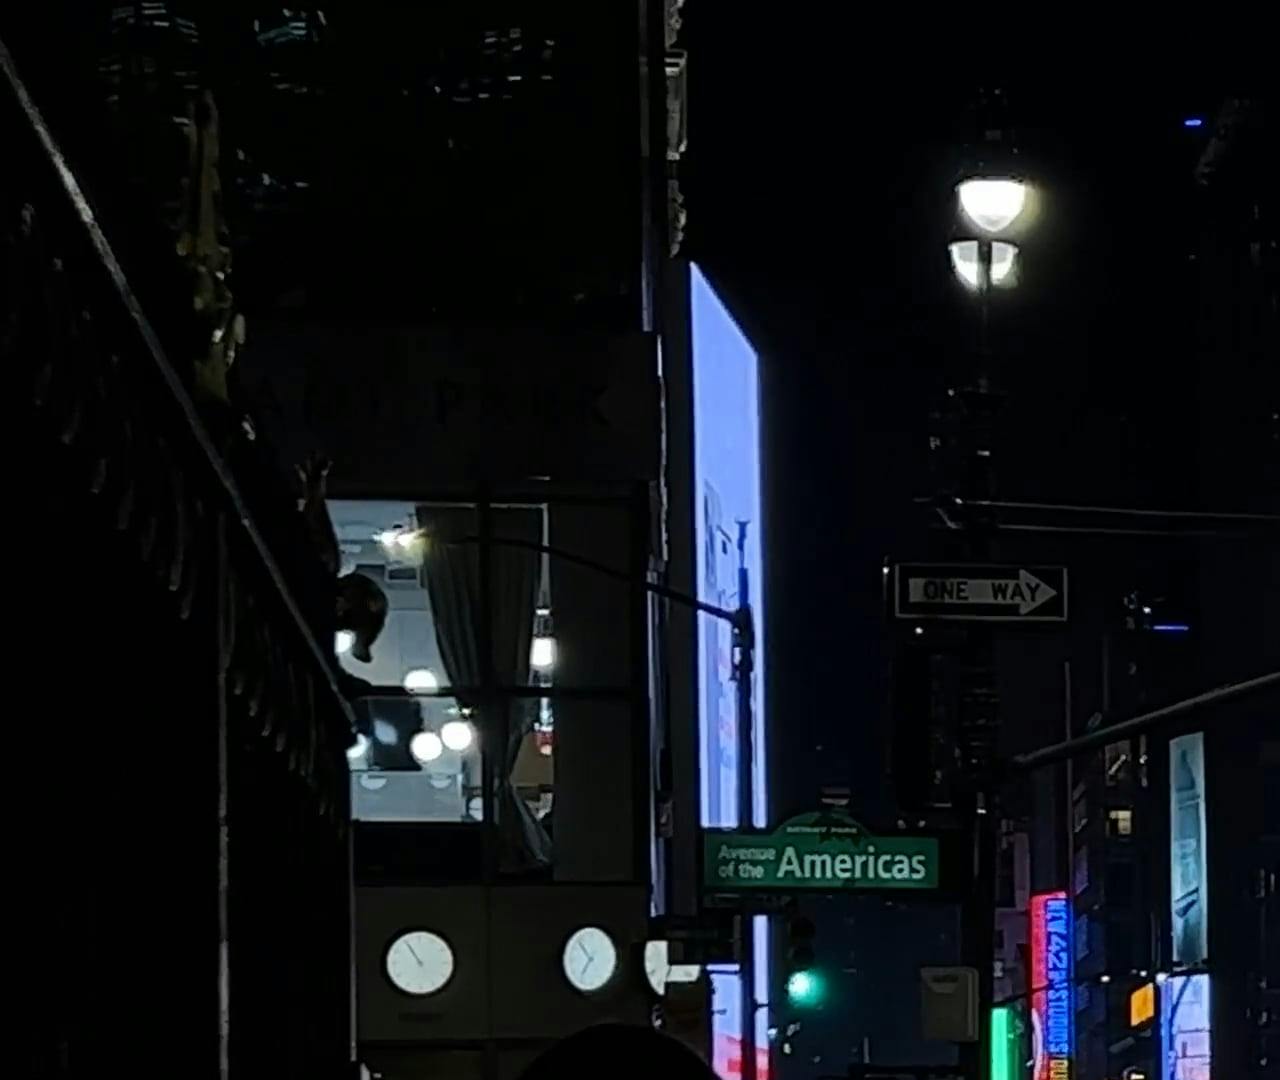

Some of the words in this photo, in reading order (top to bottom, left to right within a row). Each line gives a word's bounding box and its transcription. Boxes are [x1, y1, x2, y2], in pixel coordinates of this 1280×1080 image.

[923, 580, 969, 601] ONE
[991, 581, 1040, 602] WAY
[717, 845, 776, 860] Avenue
[776, 845, 926, 880] Americas
[717, 860, 736, 880] of
[738, 862, 765, 879] the
